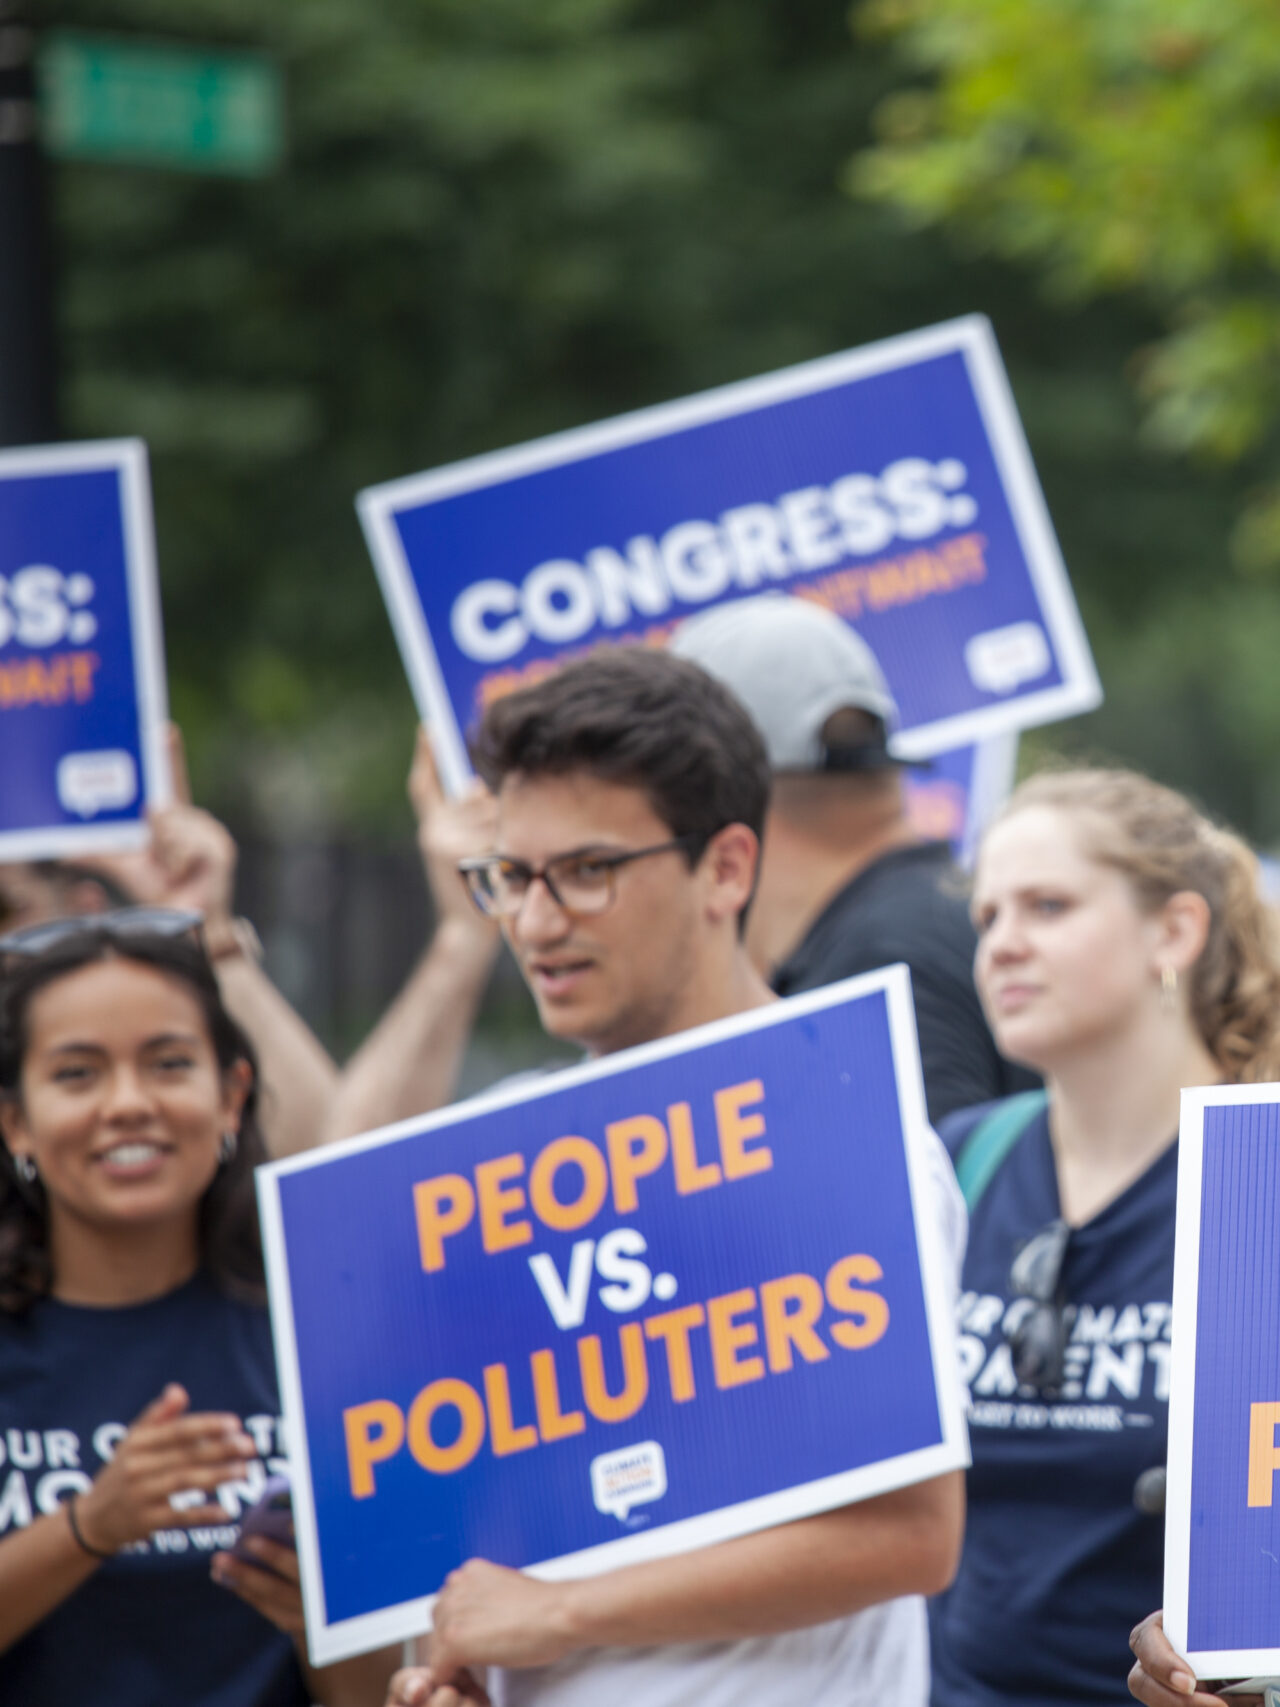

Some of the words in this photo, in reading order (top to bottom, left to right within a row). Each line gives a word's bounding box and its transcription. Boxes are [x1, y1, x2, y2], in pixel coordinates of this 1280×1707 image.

[451, 458, 979, 662] CONGRESS:
[413, 1080, 773, 1273] PEOPLE
[528, 1228, 677, 1330] VS.
[0, 1422, 81, 1470] UR
[343, 1254, 890, 1499] POLLUTERS
